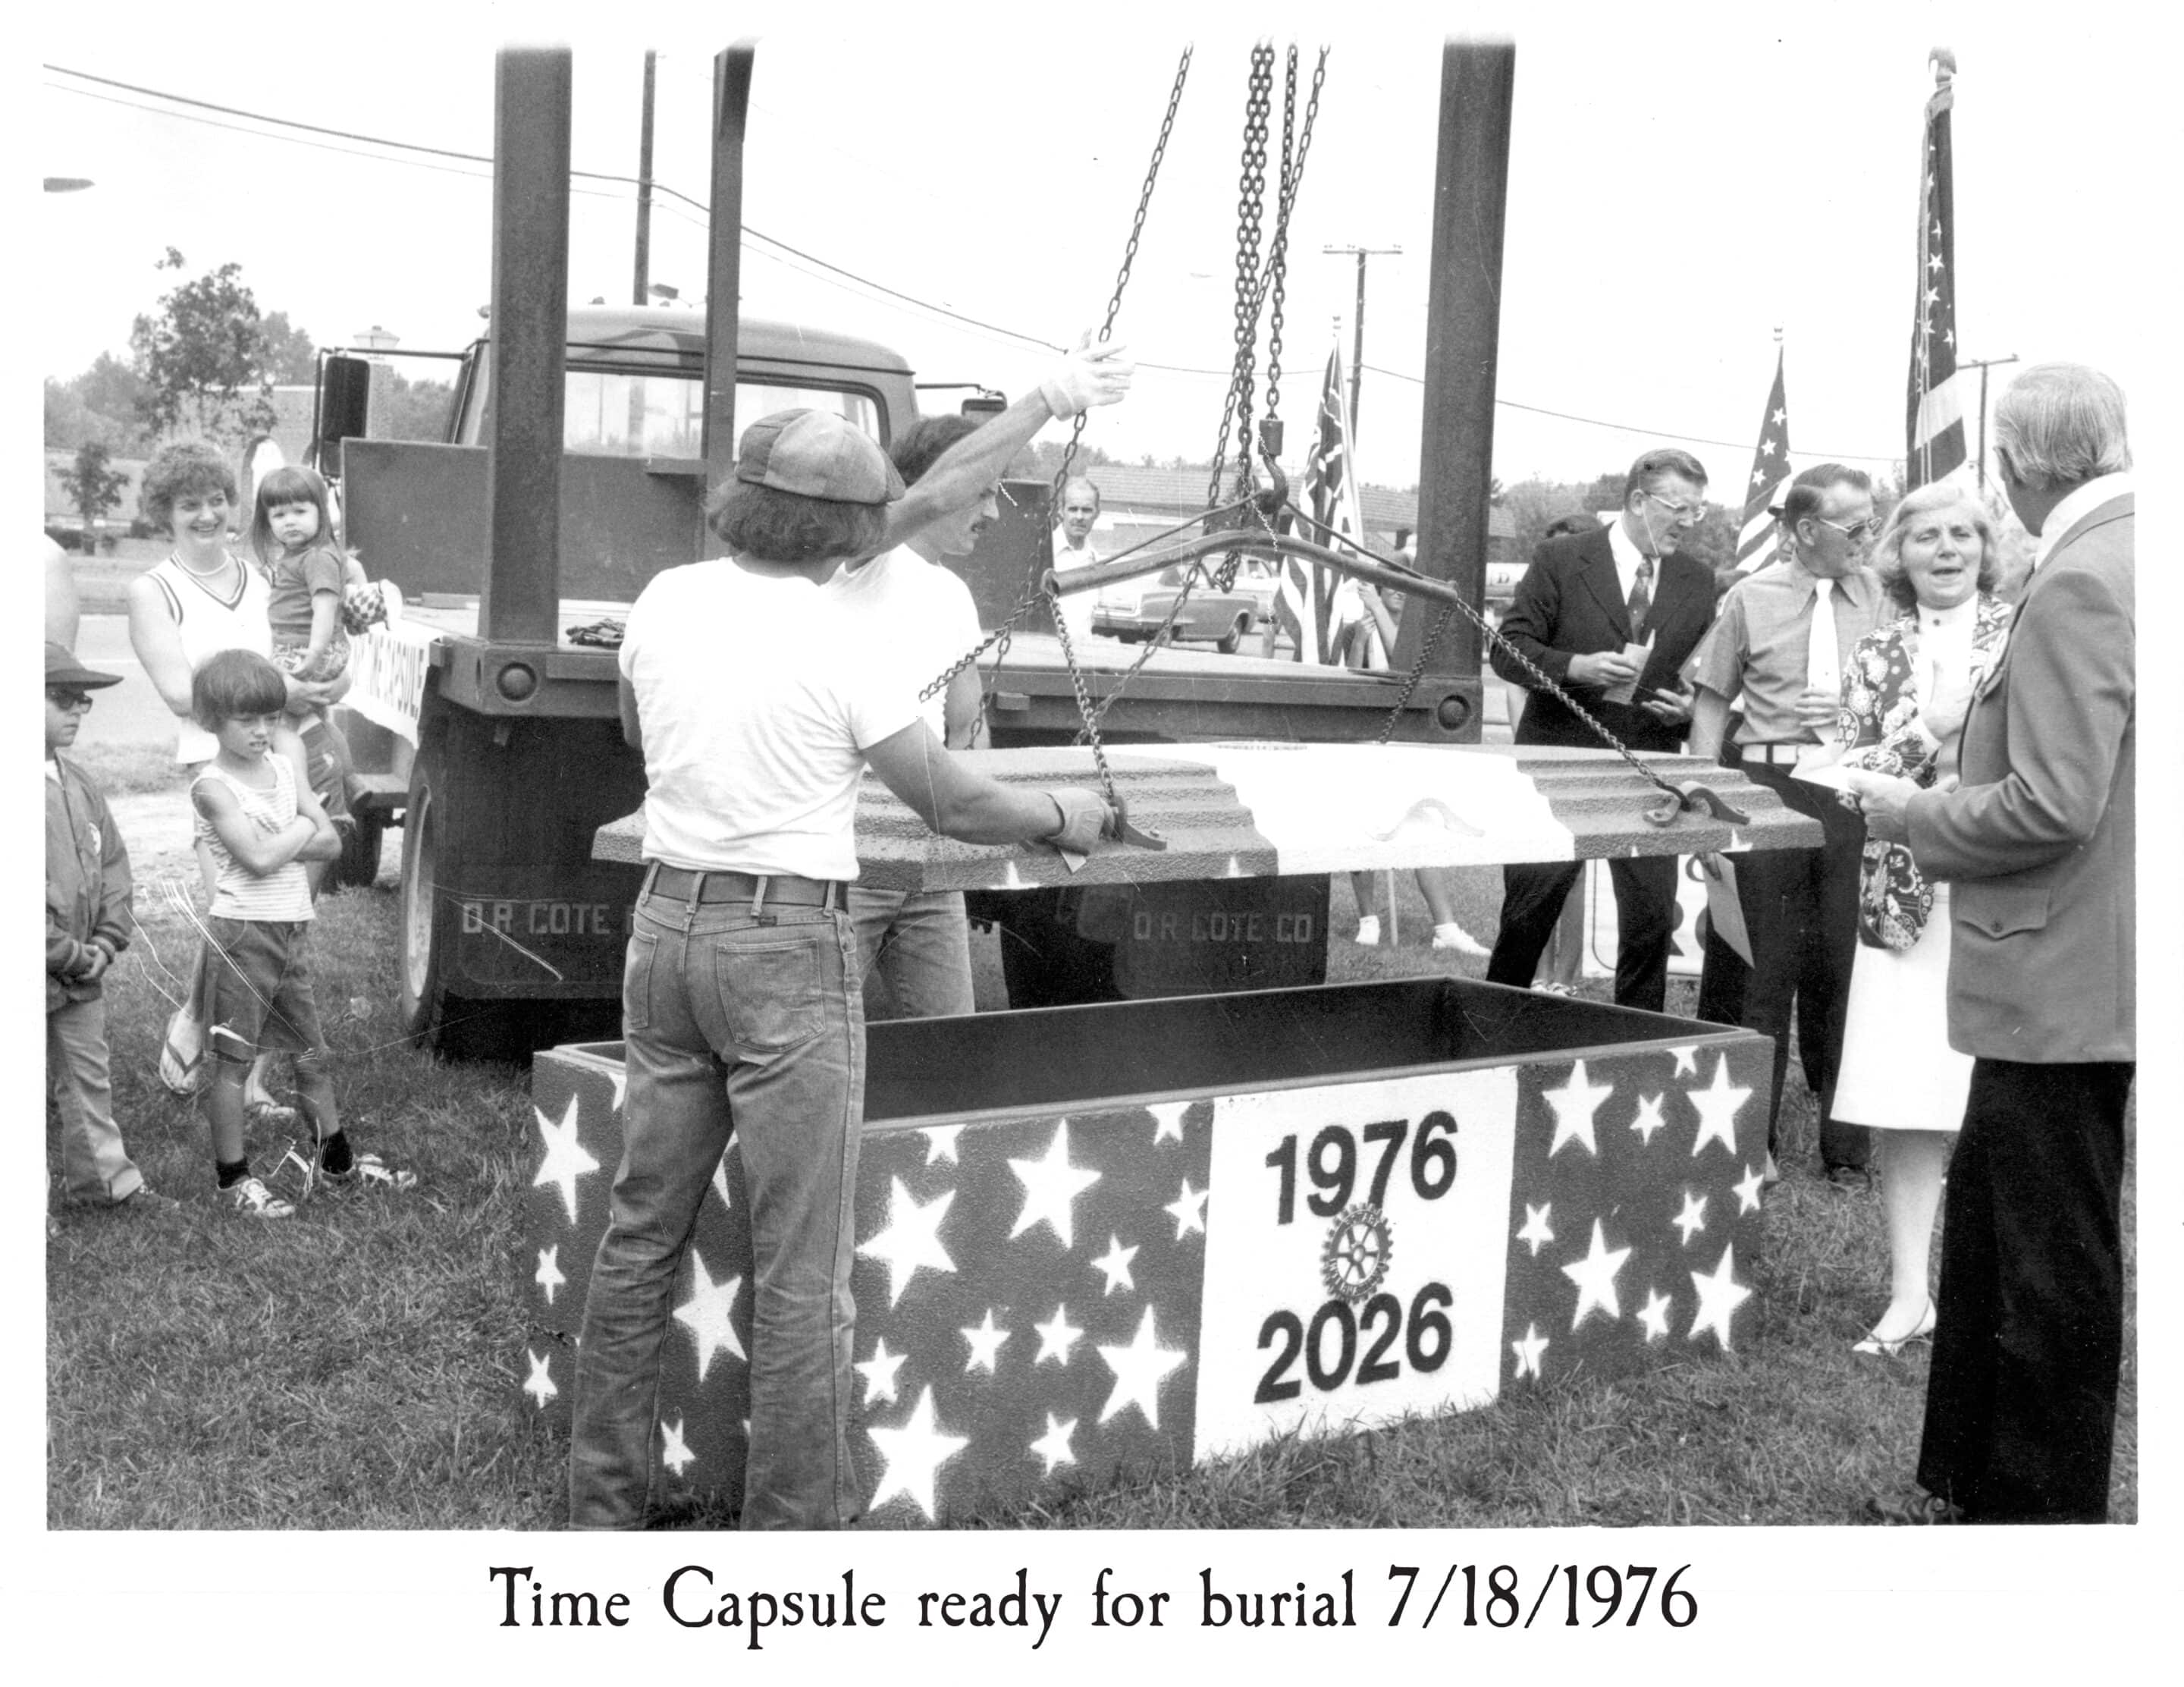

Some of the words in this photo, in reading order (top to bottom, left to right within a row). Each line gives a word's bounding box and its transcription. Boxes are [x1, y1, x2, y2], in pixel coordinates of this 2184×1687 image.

[529, 903, 610, 935] COTE
[1191, 912, 1263, 942] COTE
[1277, 913, 1313, 943] CO
[1266, 1111, 1458, 1224] 1976
[1254, 1281, 1454, 1404] 2026
